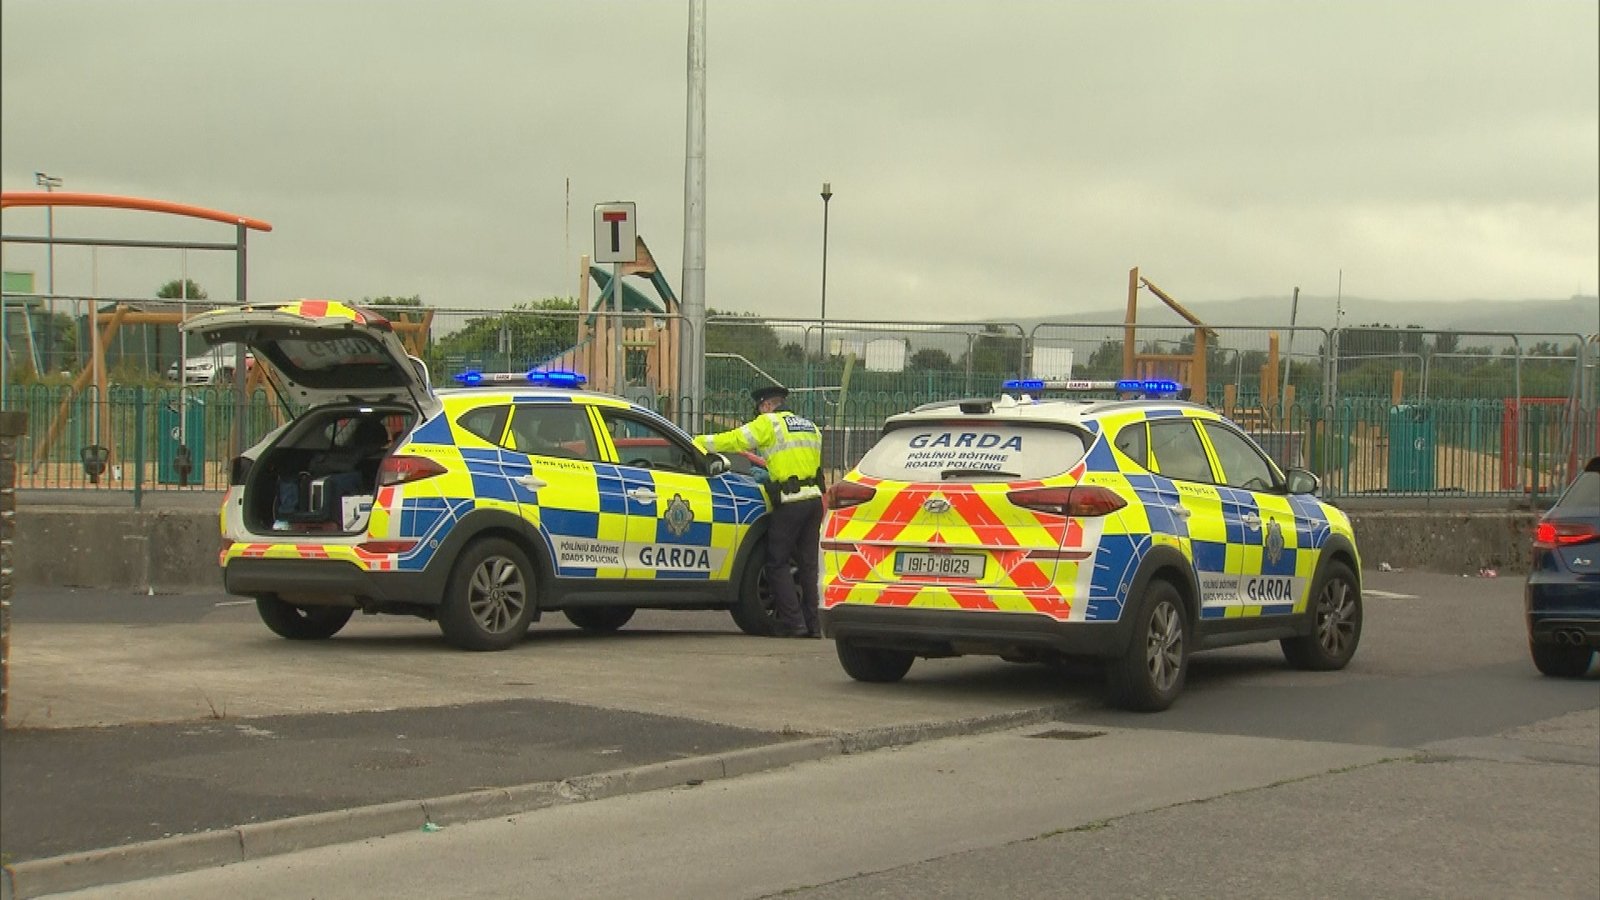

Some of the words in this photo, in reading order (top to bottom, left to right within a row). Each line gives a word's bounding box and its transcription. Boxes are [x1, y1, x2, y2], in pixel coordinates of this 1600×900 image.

[909, 432, 1023, 453] GARDA
[946, 461, 1002, 470] POLICING
[560, 541, 589, 552] PÓILÍNIÚ
[590, 543, 620, 554] BÓITHRE
[560, 552, 584, 562] ROADS
[585, 554, 619, 564] POLICING
[639, 546, 711, 569] GARDA
[908, 557, 970, 574] 191-D-18129
[1247, 579, 1293, 601] GARDA
